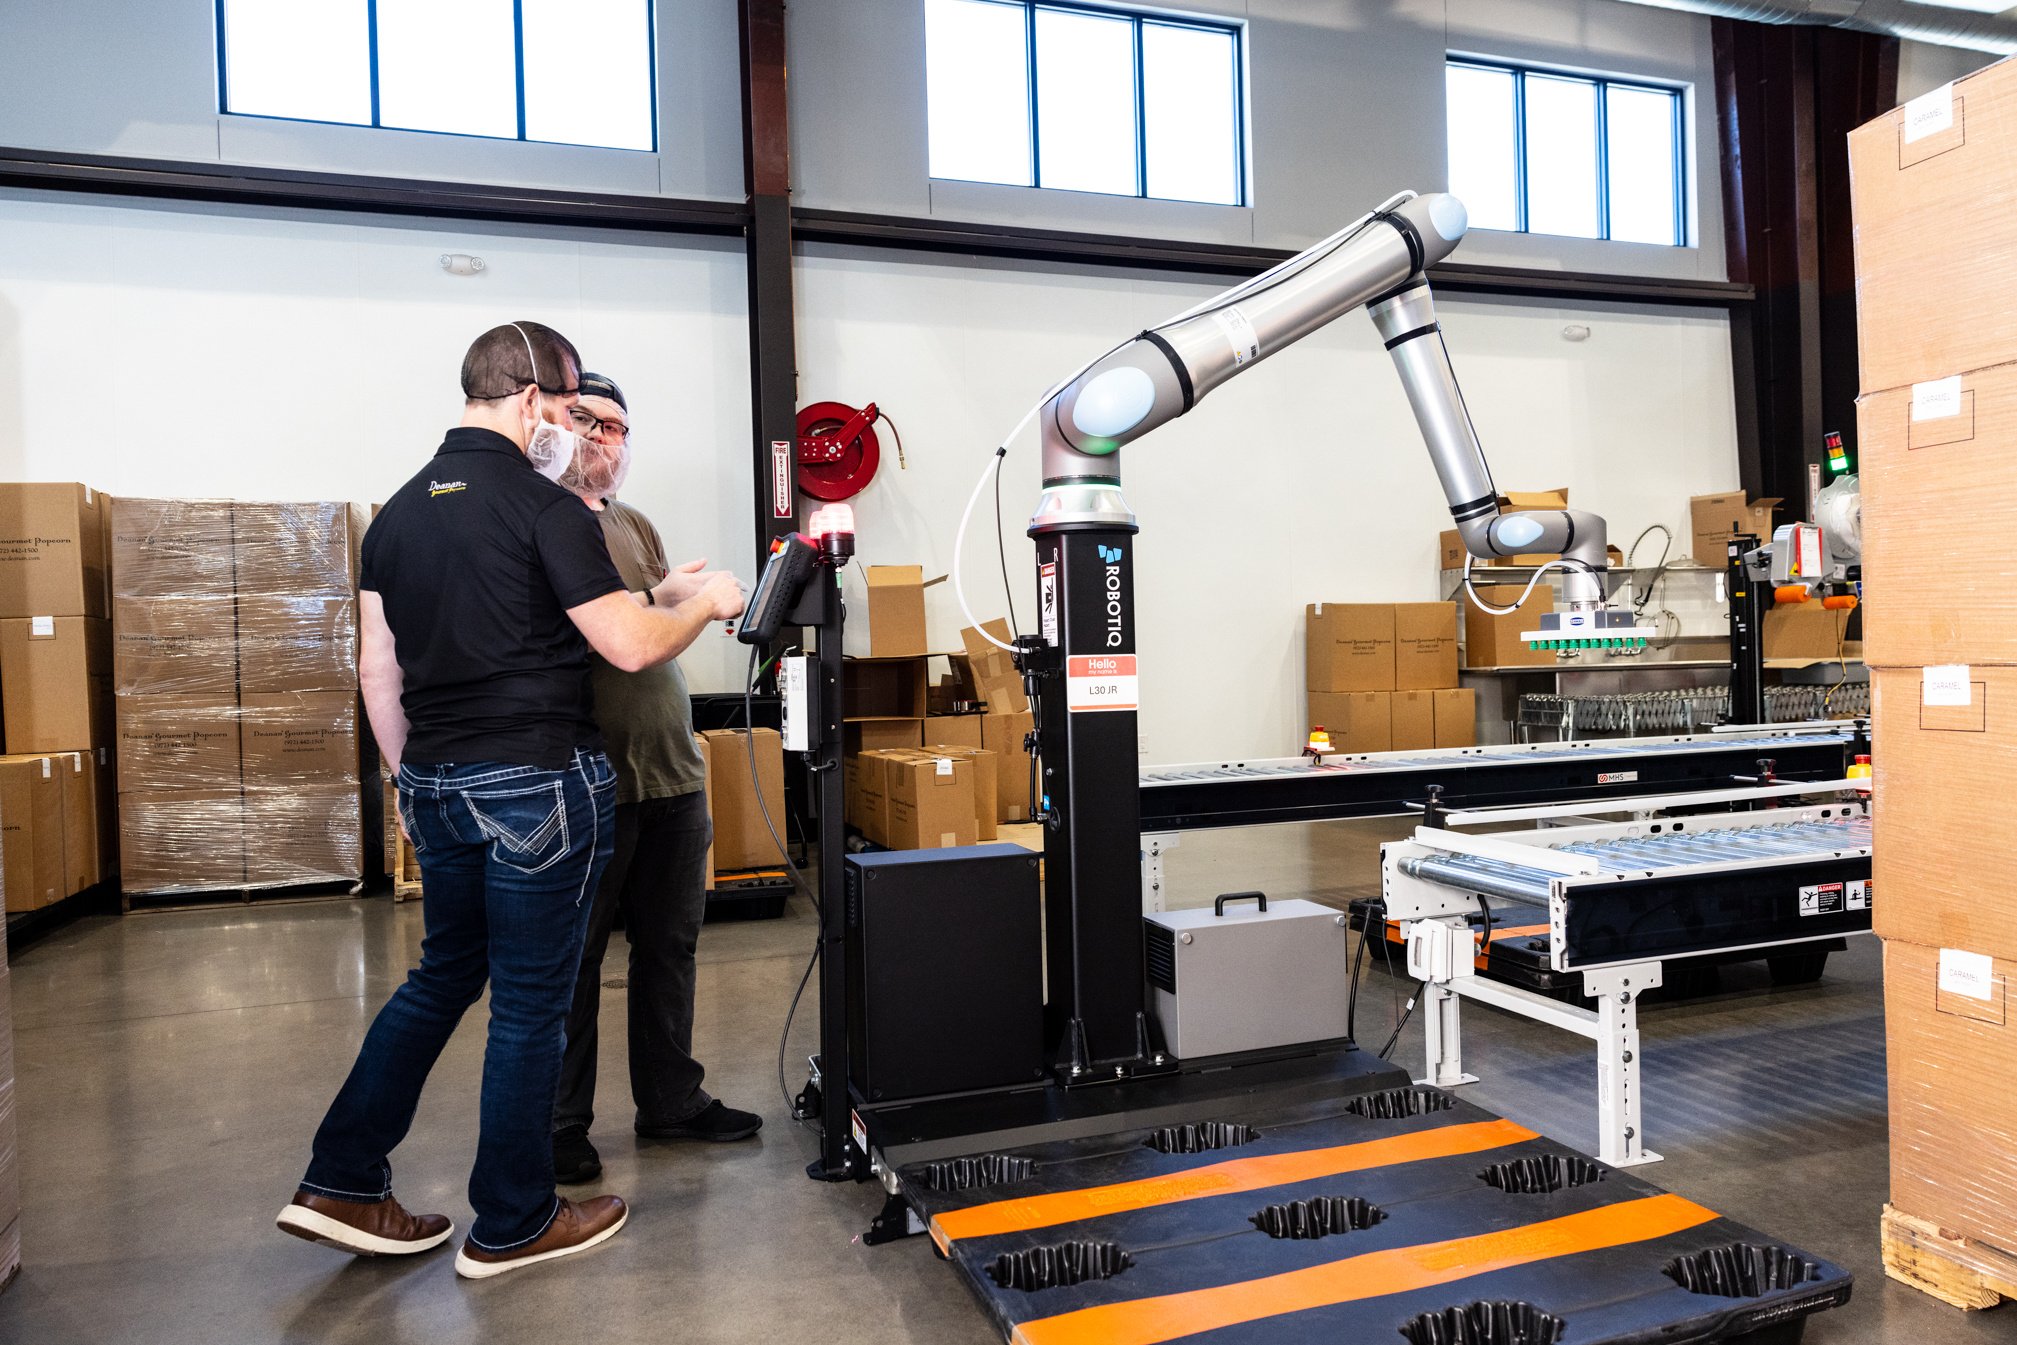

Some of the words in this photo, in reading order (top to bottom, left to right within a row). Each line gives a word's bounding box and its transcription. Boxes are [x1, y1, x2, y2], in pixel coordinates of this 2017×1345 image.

[1912, 109, 1943, 126] CARAMEL
[1922, 393, 1951, 405] CARAMEL
[35, 537, 71, 546] Popcorn
[1106, 565, 1122, 647] ROBOTIQ
[1088, 658, 1117, 669] Hello
[1089, 686, 1105, 695] L30
[1108, 685, 1118, 694] JR
[1932, 682, 1961, 691] CARAMEL
[156, 732, 191, 741] Gourmet
[193, 731, 228, 741] Popcorn
[285, 730, 318, 738] Gourmet
[1609, 773, 1624, 781] MHS
[1949, 968, 1979, 983] CARAMEL
